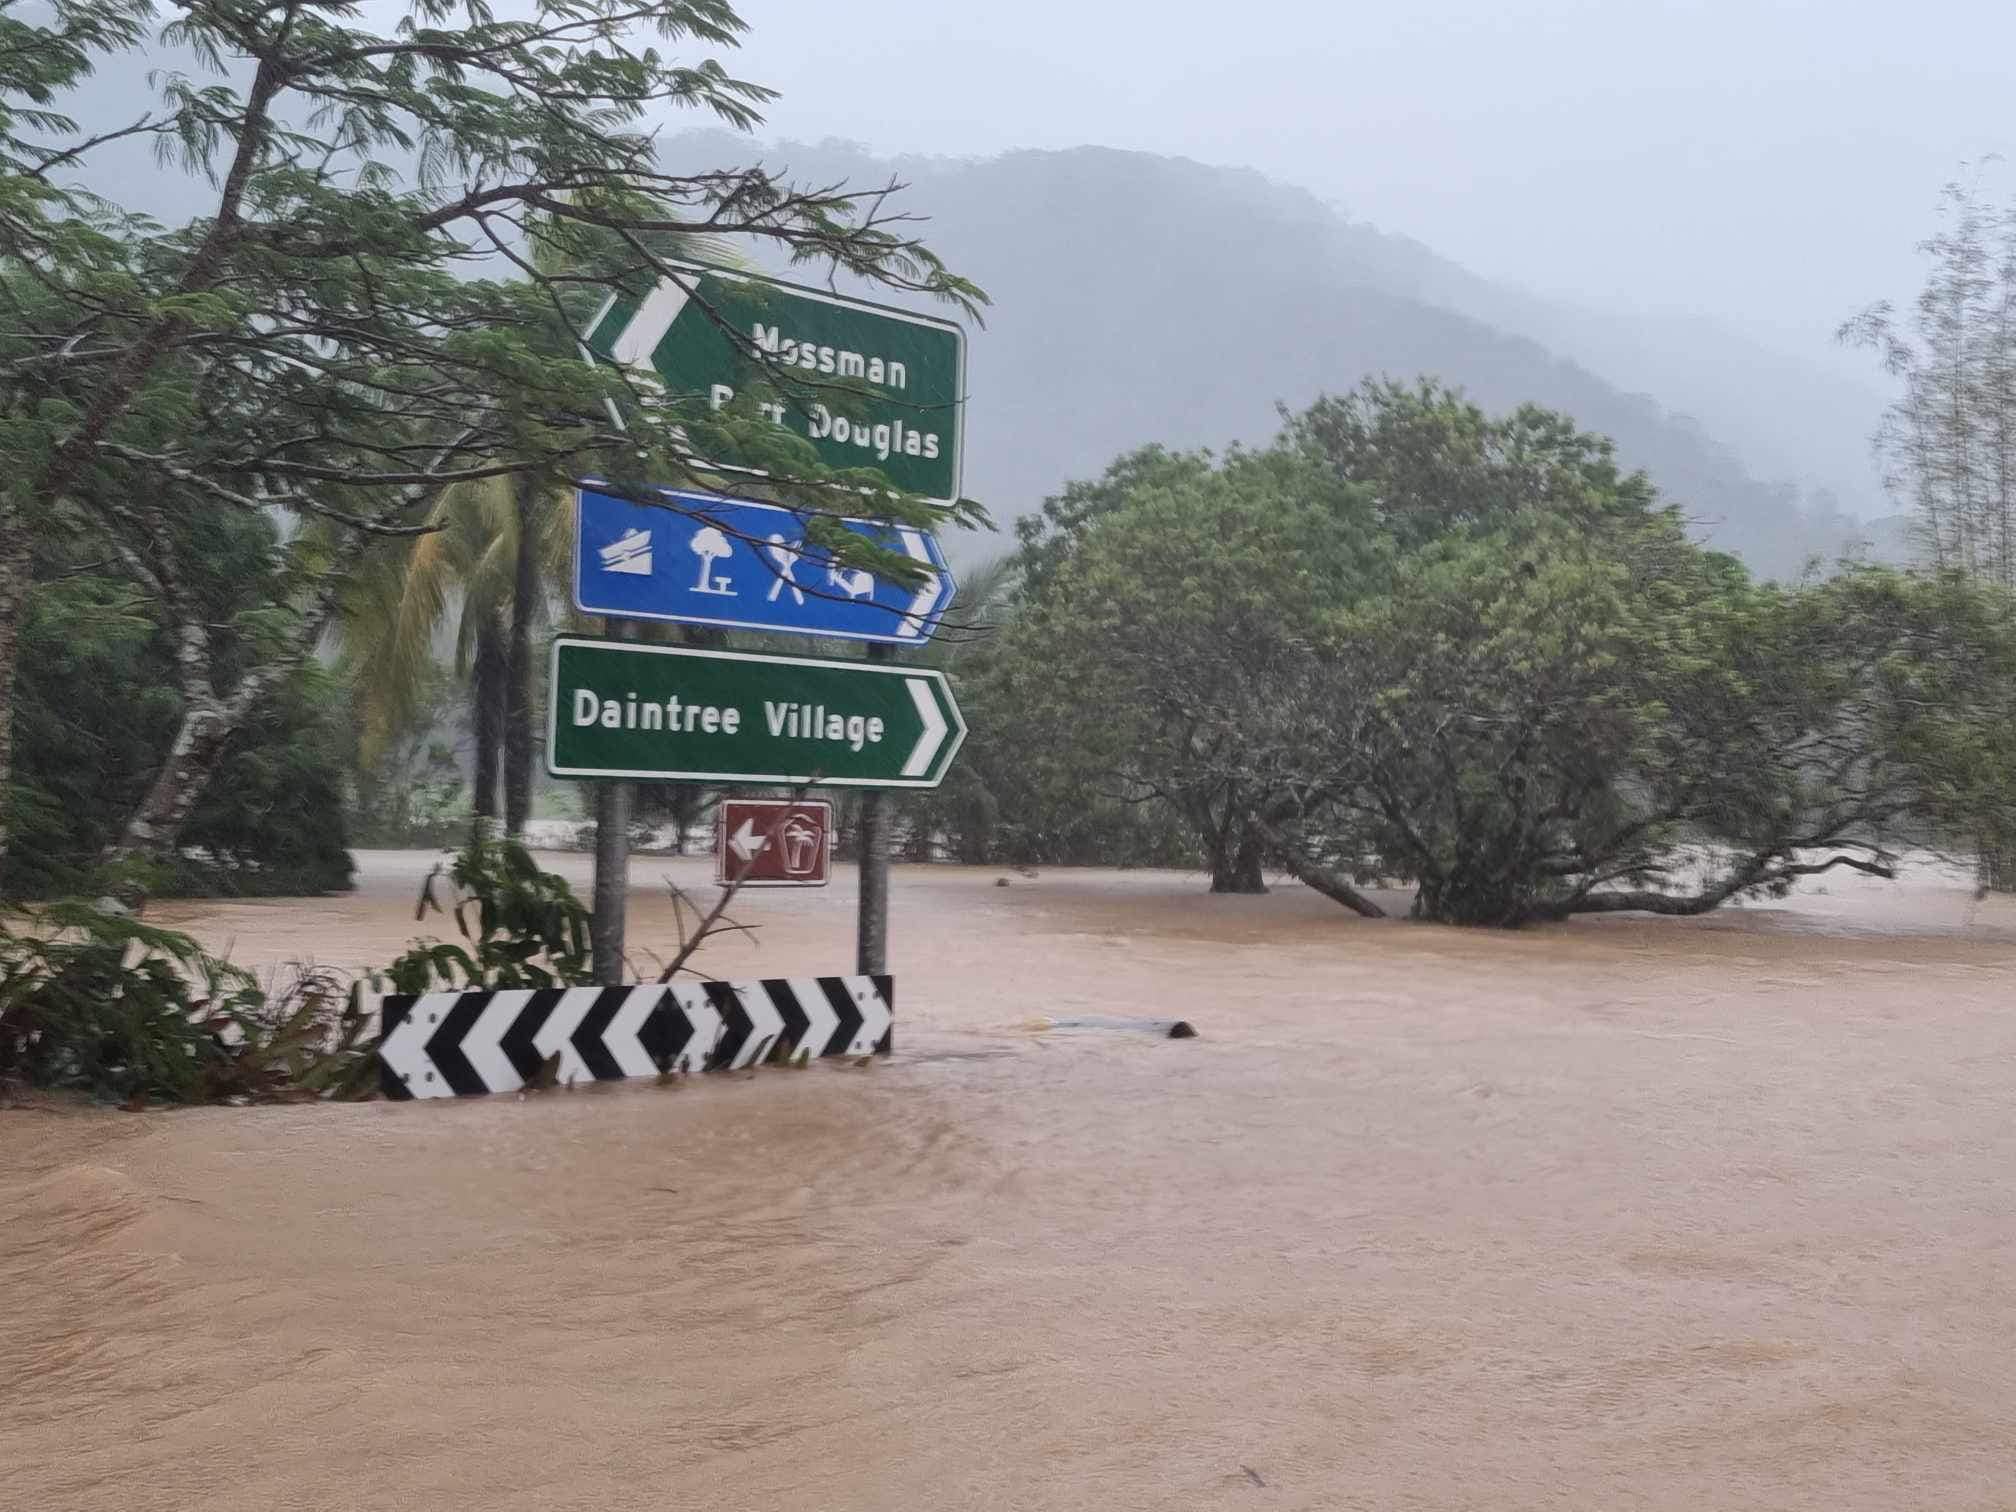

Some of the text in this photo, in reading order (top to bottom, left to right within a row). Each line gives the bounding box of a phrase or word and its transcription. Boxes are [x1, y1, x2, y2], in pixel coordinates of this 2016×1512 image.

[751, 322, 906, 389] Mossman
[710, 384, 939, 461] Pt Douglas
[573, 688, 885, 752] Daintree Village
